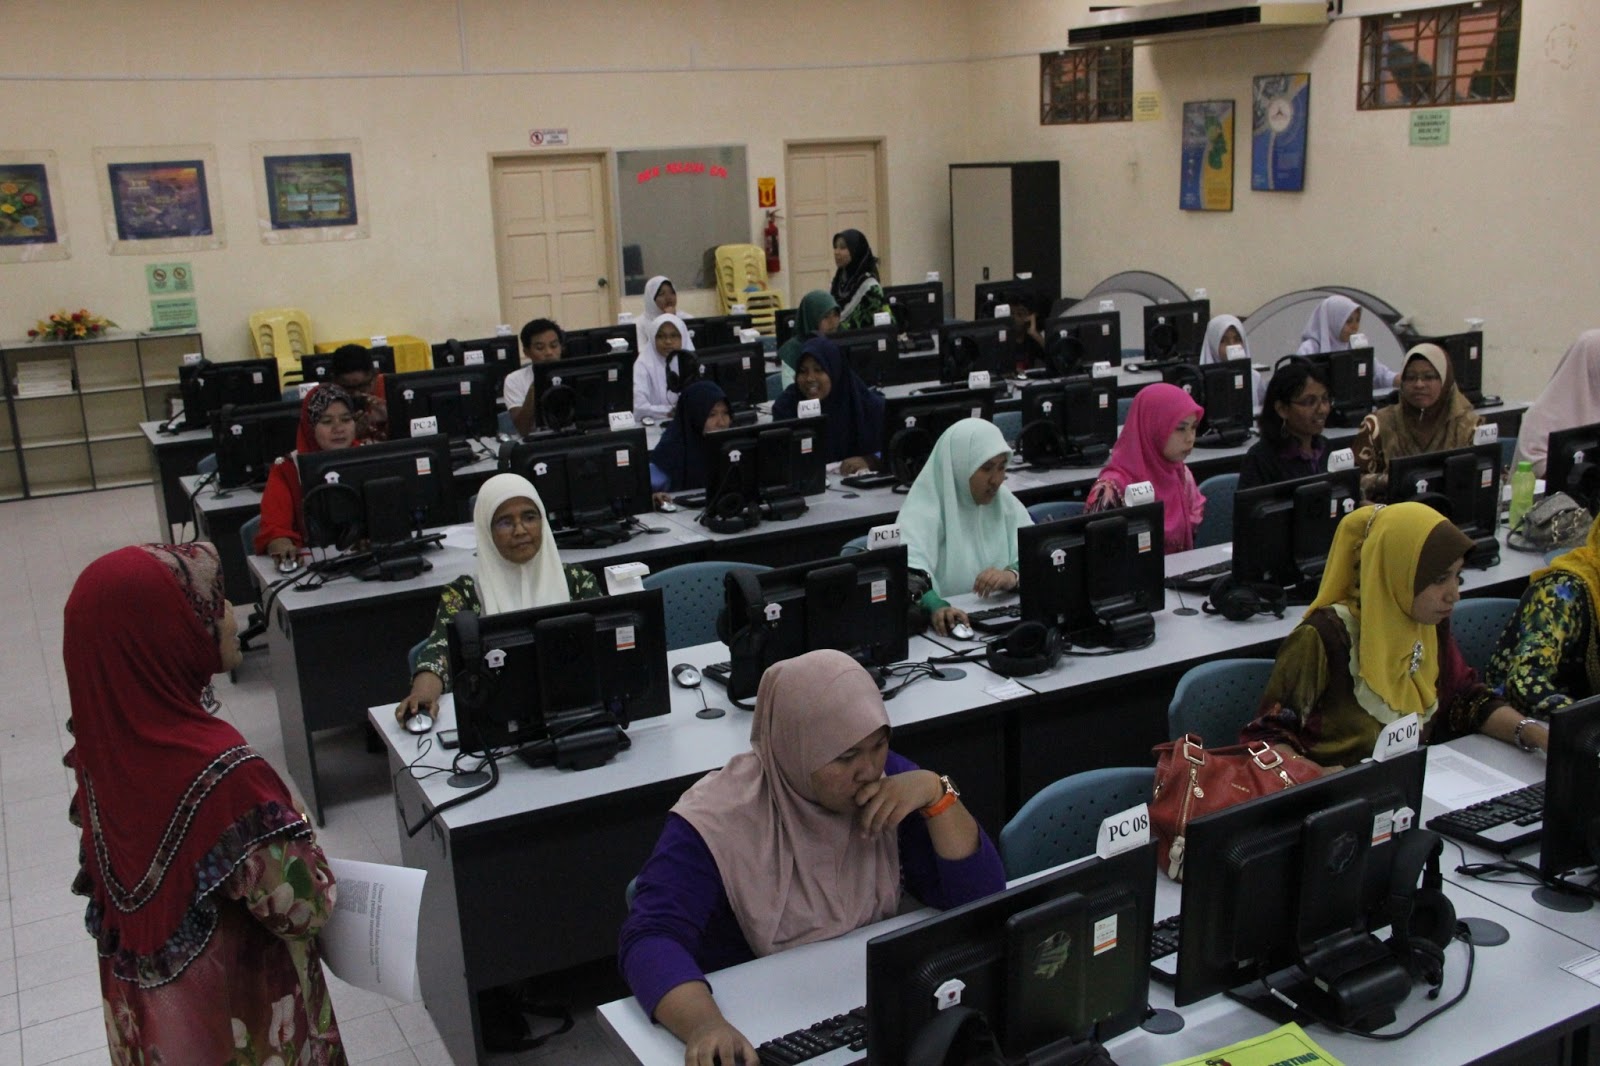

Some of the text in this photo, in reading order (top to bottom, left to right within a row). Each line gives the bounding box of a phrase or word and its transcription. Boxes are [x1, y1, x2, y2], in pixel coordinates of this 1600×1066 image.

[801, 403, 812, 412] PC
[611, 413, 623, 422] PC
[413, 420, 437, 431] PC 24
[1480, 428, 1491, 438] PC
[1335, 453, 1346, 464] PC
[1131, 485, 1145, 497] PC
[874, 528, 901, 542] PC 15
[1387, 722, 1419, 746] PC 07
[1108, 813, 1149, 842] PC 08
